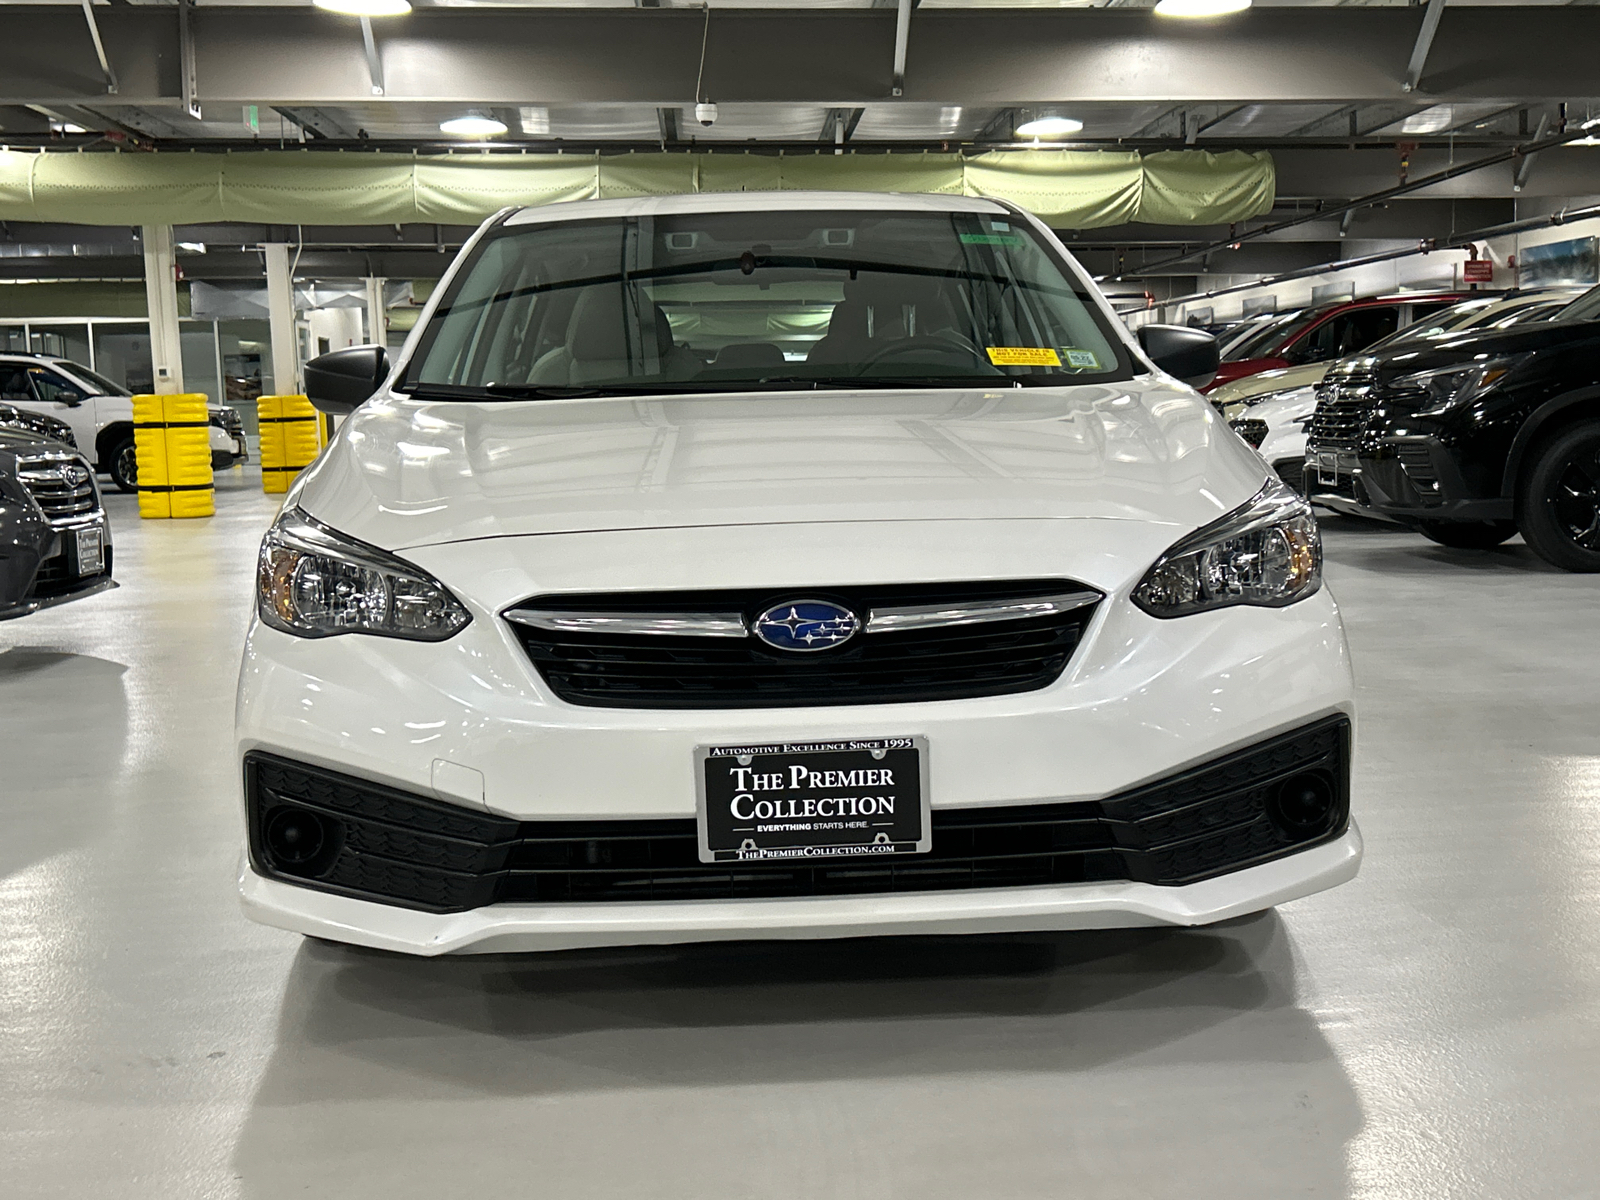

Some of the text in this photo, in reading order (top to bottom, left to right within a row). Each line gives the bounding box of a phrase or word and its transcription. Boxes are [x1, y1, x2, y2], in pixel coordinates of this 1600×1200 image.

[712, 738, 912, 756] AUTOMOTIVE EXCELLENCE SINCE 1995
[729, 765, 895, 792] THE PREMIER
[730, 794, 896, 820] COLLECTION
[757, 821, 869, 832] EVERYTHING STARTS HERE.
[736, 845, 895, 860] THEPREMIERCOLLECTION.COM
